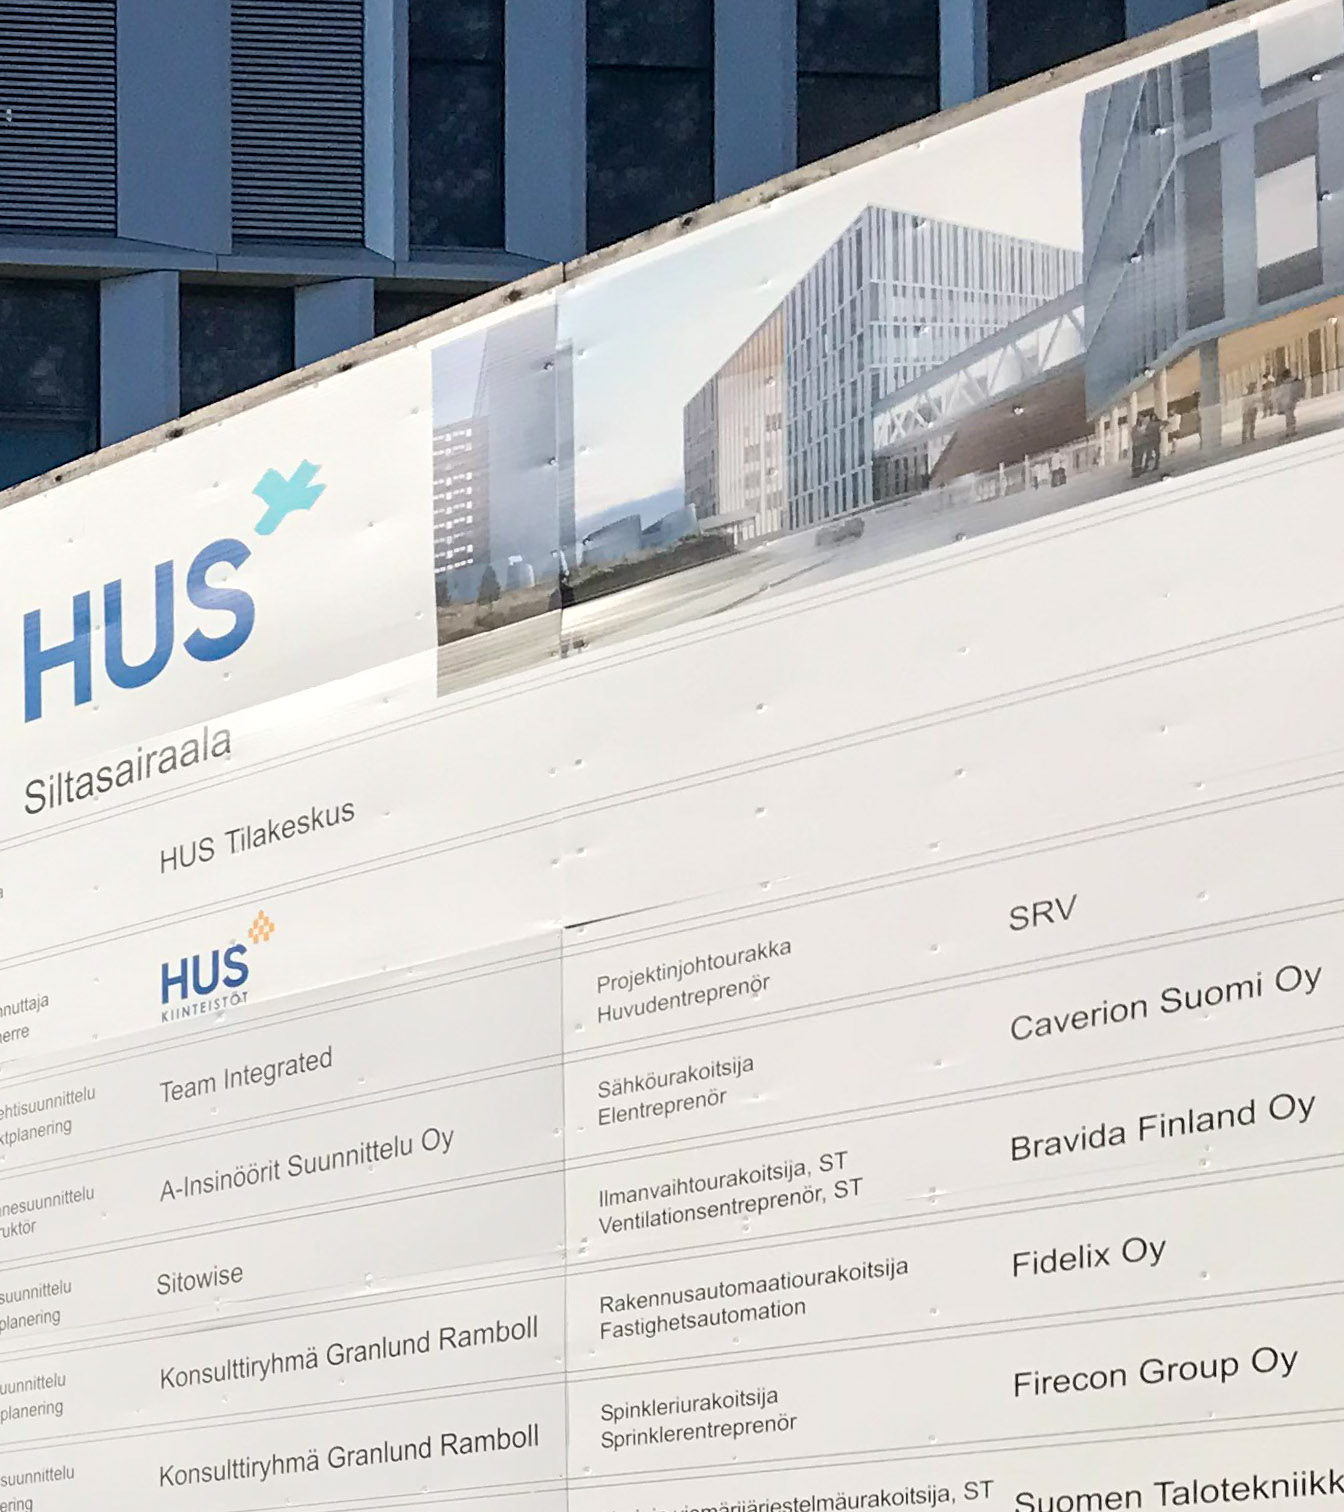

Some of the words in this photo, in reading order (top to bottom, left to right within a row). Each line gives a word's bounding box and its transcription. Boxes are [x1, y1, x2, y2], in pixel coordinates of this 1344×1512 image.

[23, 537, 255, 723] HUS
[24, 725, 231, 816] Siltasairaala
[161, 836, 215, 875] HUS
[225, 802, 355, 856] Tilakeskus
[1009, 894, 1078, 931] SRV
[161, 943, 249, 1004] HUS
[597, 939, 791, 993] Projektinjohtourakka
[161, 991, 248, 1022] KIINTEISTÖT
[598, 975, 770, 1023] Huvudentreprenör
[1011, 998, 1147, 1041] Caverion
[1161, 972, 1262, 1014] Suomi
[1276, 965, 1322, 995] Oy
[161, 1076, 216, 1103] Team
[224, 1046, 332, 1090] Integrated
[598, 1056, 754, 1099] Sähköurakoitsija
[598, 1088, 726, 1126] Elentreprenör
[1012, 1124, 1125, 1161] Bravida
[1139, 1100, 1255, 1141] Finland
[1270, 1093, 1316, 1123] Oy
[160, 1159, 280, 1201] A-Insinöörit
[288, 1135, 413, 1176] Suunnittelu
[422, 1127, 454, 1154] Oy
[599, 1160, 811, 1208] Ilmanvaihtourakoitsija,
[819, 1151, 848, 1172] ST
[599, 1186, 826, 1234] Ventilationsentreprenör,
[834, 1179, 863, 1198] ST
[157, 1264, 243, 1296] Sitowise
[1013, 1243, 1110, 1278] Fidelix
[1122, 1237, 1166, 1266] Oy
[600, 1258, 908, 1313] Rakennusautomaatiourakoitsija
[600, 1299, 806, 1339] Fastighetsautomation
[160, 1347, 318, 1389] Konsulttiryhmä
[327, 1331, 430, 1366] Granlund
[439, 1315, 538, 1350] Ramboll
[1014, 1367, 1126, 1397] Firecon
[1140, 1357, 1239, 1384] Group
[1252, 1347, 1298, 1377] Oy
[601, 1388, 778, 1423] Spinkleriurakoitsija
[601, 1414, 797, 1451] Sprinklerentreprenör
[160, 1450, 319, 1487] Konsulttiryhmä
[328, 1436, 431, 1468] Granlund
[441, 1424, 539, 1456] Ramboll
[964, 1480, 993, 1500] ST
[1154, 1469, 1344, 1507] Talotekniikk
